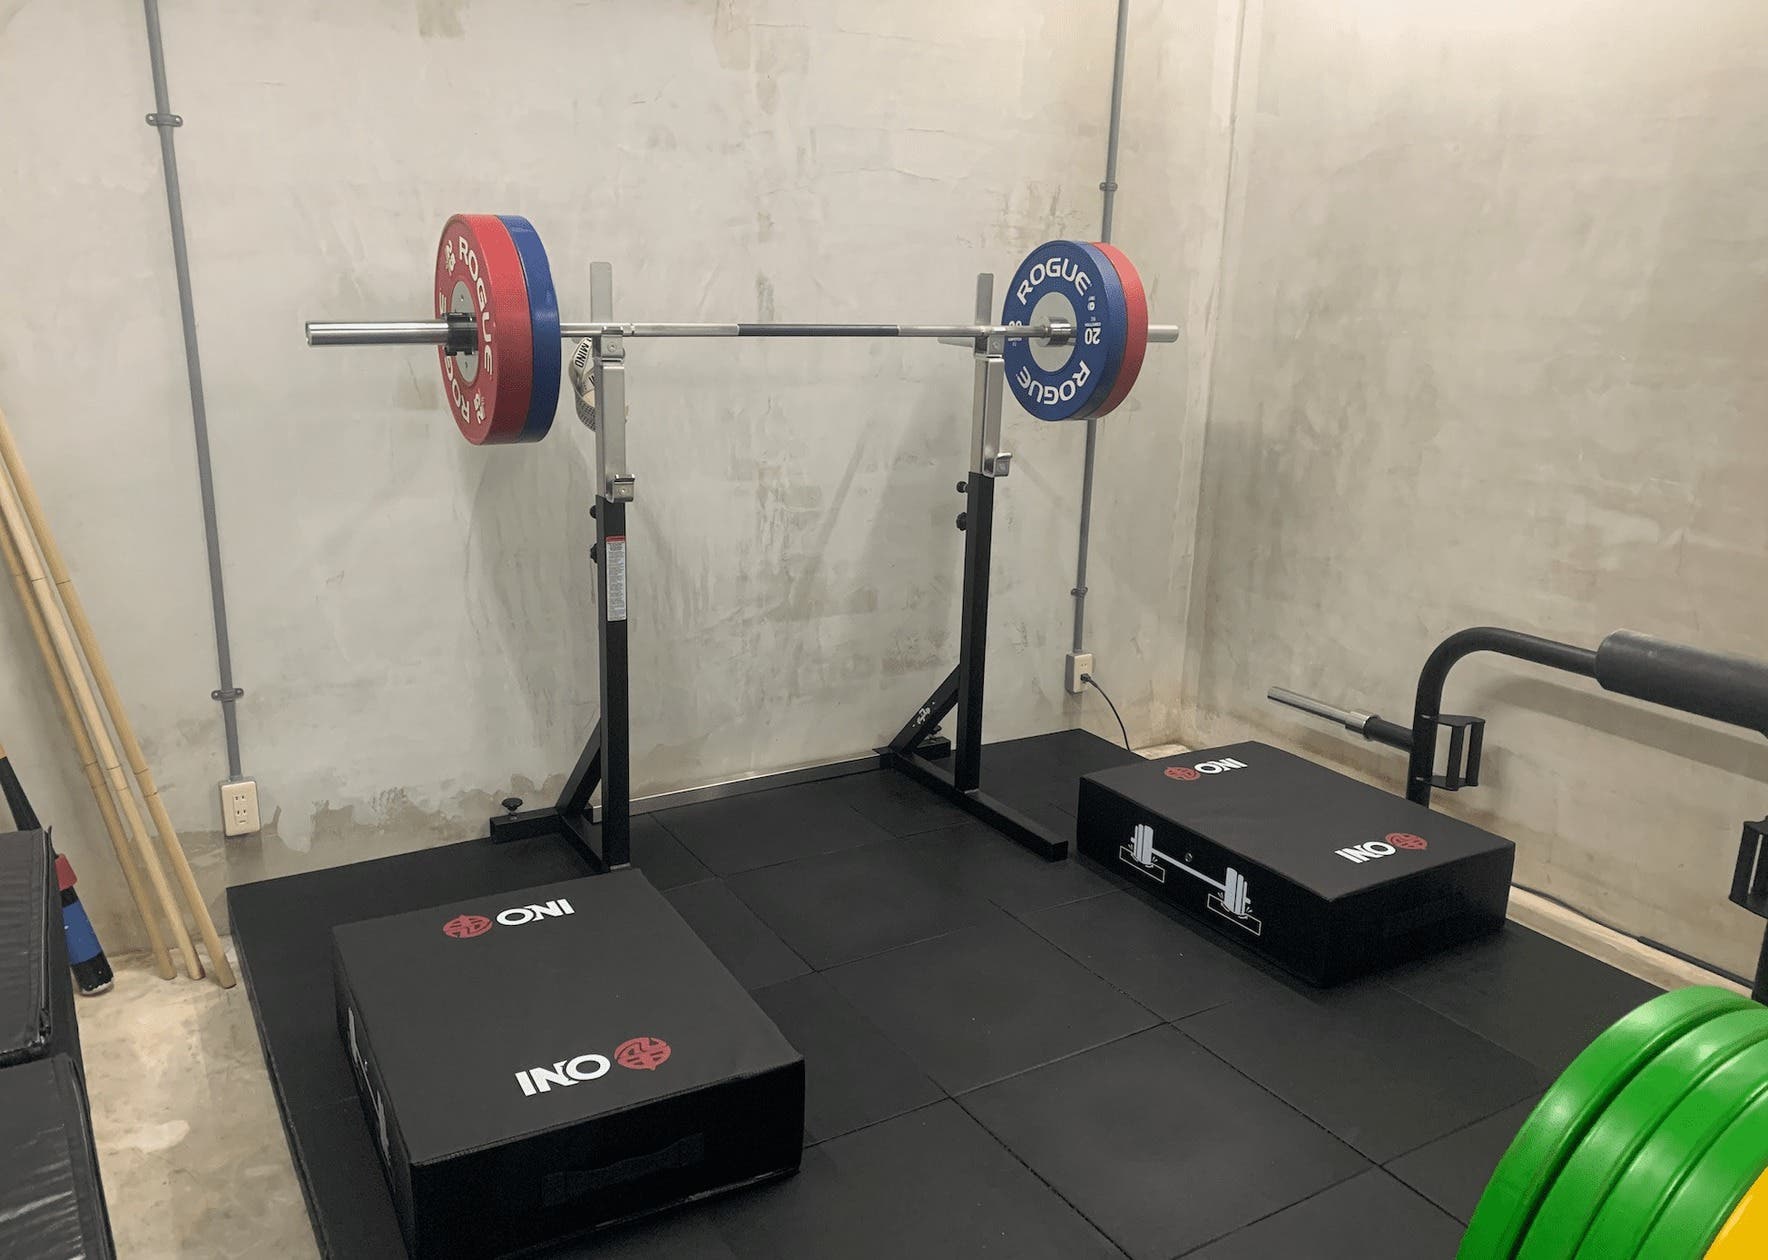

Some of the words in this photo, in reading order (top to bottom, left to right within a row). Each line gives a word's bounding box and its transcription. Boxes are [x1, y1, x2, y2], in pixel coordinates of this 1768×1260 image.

[1016, 257, 1091, 305] ROGUE
[459, 235, 492, 373] ROGUE
[1085, 327, 1101, 344] 20
[1015, 360, 1091, 405] ROGUE
[496, 898, 575, 926] ONI
